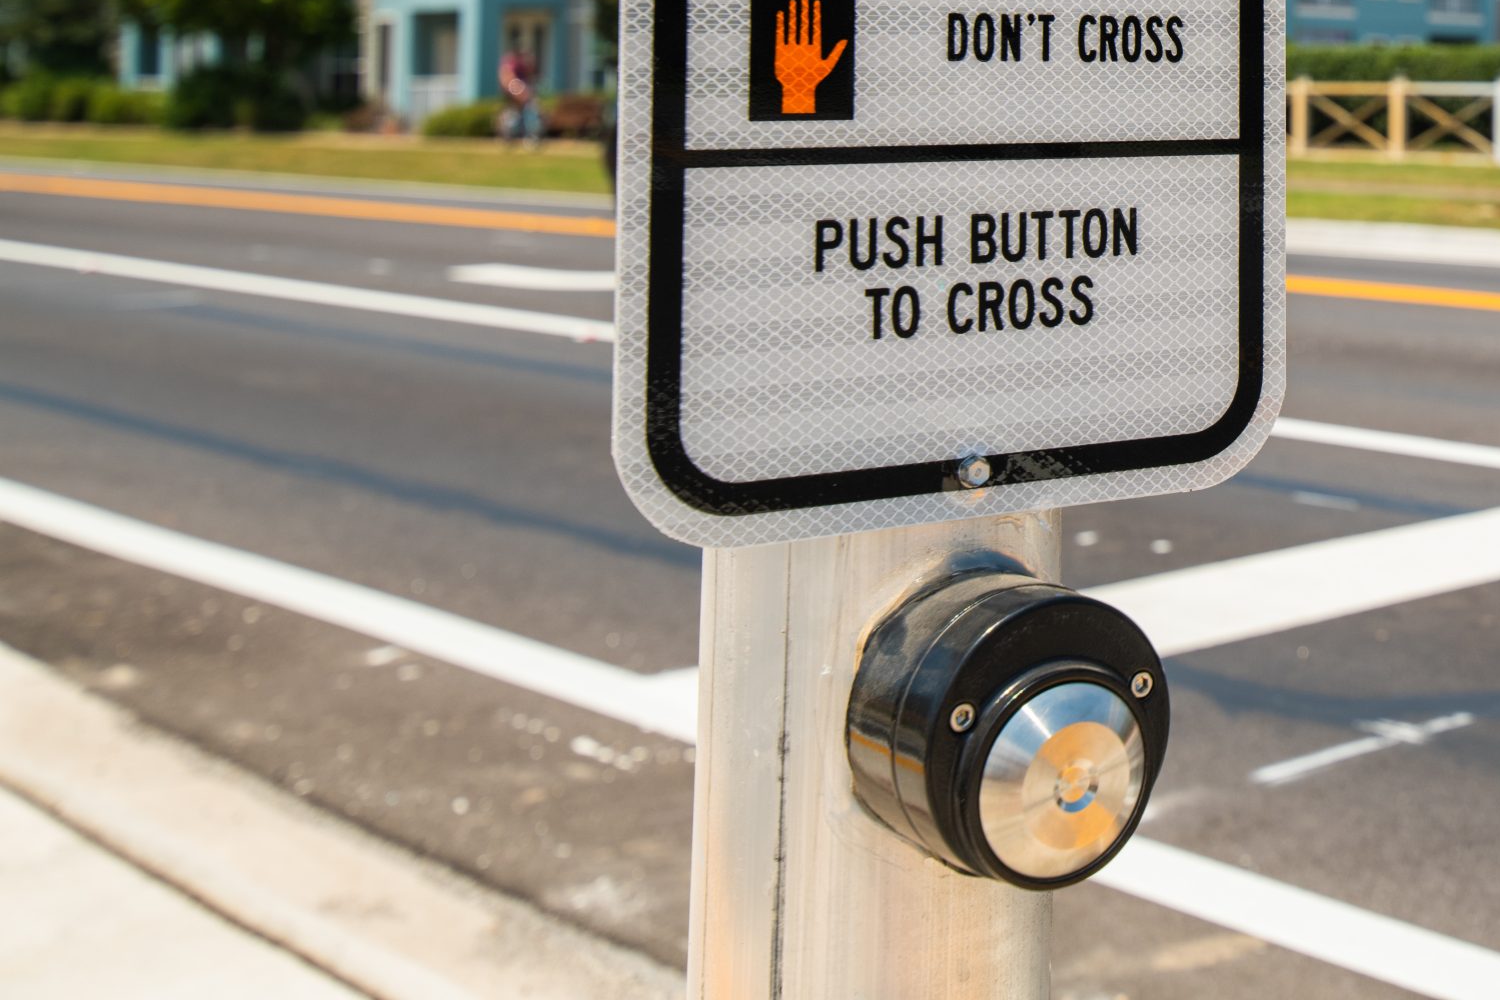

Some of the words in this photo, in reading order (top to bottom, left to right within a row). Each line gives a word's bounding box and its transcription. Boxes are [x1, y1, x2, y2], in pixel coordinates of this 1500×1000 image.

[947, 13, 1055, 63] DON'T
[1078, 15, 1184, 63] CROSS
[815, 215, 944, 272] PUSH
[970, 207, 1138, 264] BUTTON
[865, 285, 920, 340] TO
[947, 275, 1094, 335] CROSS
